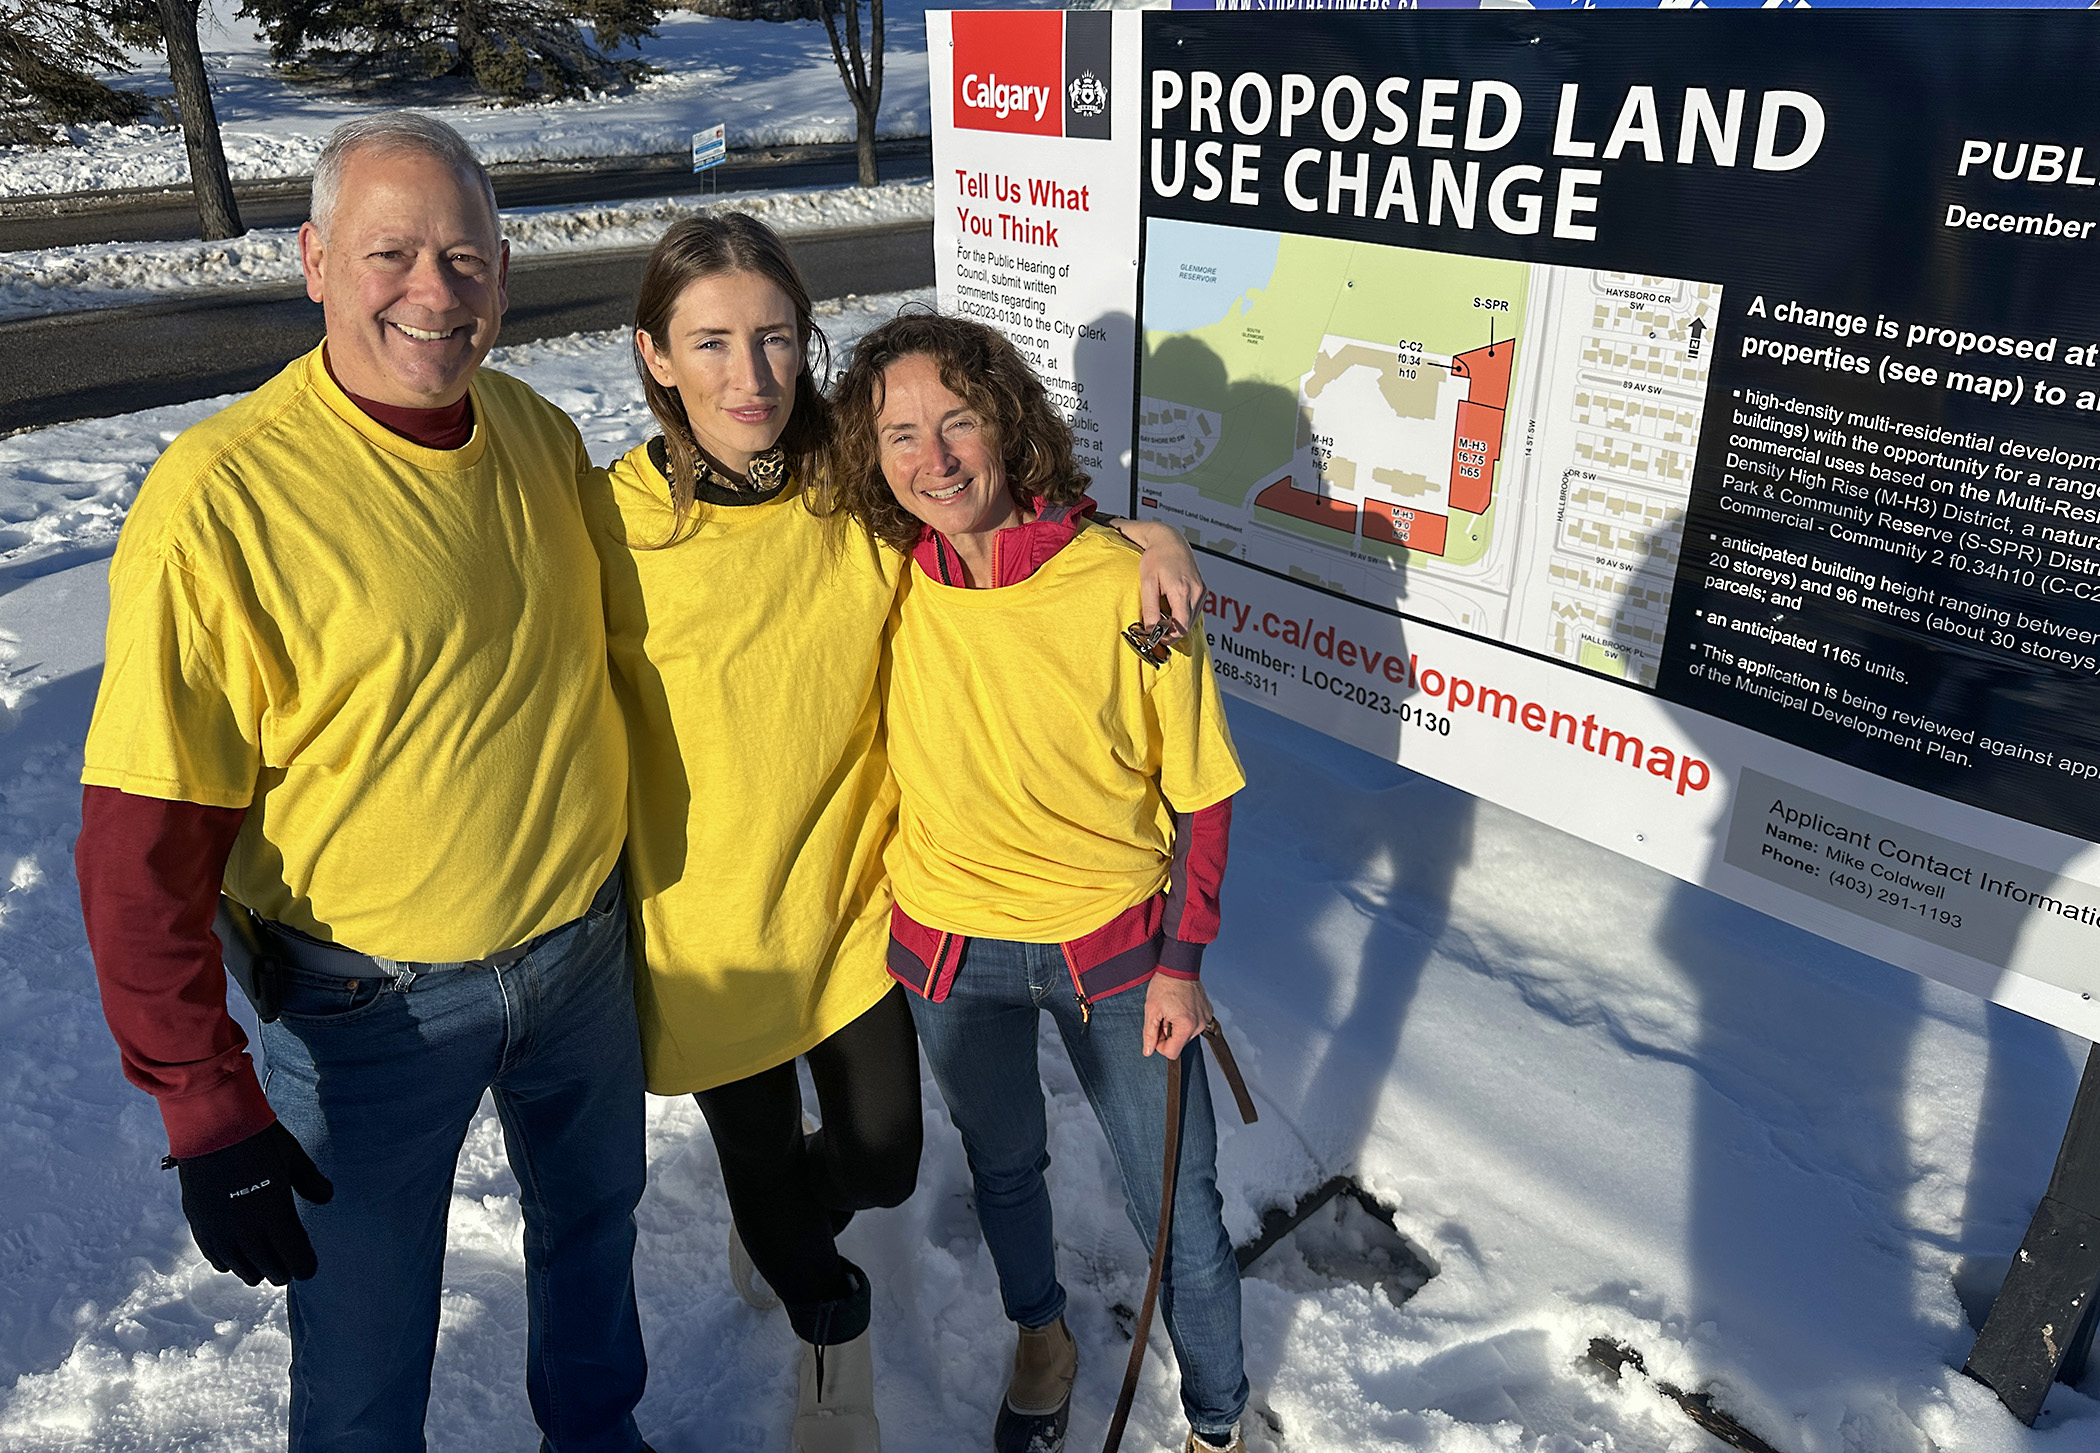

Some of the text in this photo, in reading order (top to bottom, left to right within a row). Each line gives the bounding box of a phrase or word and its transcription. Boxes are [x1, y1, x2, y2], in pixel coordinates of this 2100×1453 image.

[962, 74, 1049, 122] Calgary
[1150, 69, 1827, 174] PROPOSED LAND
[1957, 140, 2100, 186] PUBL
[956, 170, 1089, 211] Tell Us What
[1149, 137, 1604, 242] USE CHANGE
[957, 207, 1059, 248] You Think
[1945, 204, 2096, 239] December
[957, 246, 1069, 279] For the Public Hearing of
[957, 264, 1056, 294] Council, submit written
[1179, 272, 1217, 283] RESERVOIR
[1180, 264, 1217, 275] GLENMORE
[957, 285, 1045, 314] comments regarding
[1473, 298, 1509, 311] S-SPR
[1606, 288, 1655, 302] HAYSBORO
[1630, 302, 1644, 311] SW
[958, 300, 1107, 341] LOC2023-0130 to the City Clerk
[1747, 296, 2099, 367] A change is proposed at
[1011, 334, 1033, 346] noon
[1037, 338, 1049, 349] on
[1399, 340, 1423, 353] C-C2
[1398, 354, 1421, 366] f0.34
[1399, 368, 1416, 379] h10
[1742, 336, 2066, 405] properties (see map) to
[1623, 381, 1662, 394] 89 AV SW
[1067, 414, 1099, 432] Public
[1525, 420, 1535, 456] 14 ST SW
[1745, 389, 1994, 453] high-density multi-residential
[1311, 434, 1334, 446] M-H3
[1311, 446, 1332, 459] f5.75
[1459, 438, 1486, 452] M-H3
[1733, 409, 1809, 442] buildings)
[1814, 429, 1846, 447] with
[1852, 435, 1879, 454] the
[1883, 445, 1990, 480] opportunity
[1995, 463, 2023, 482] for
[2027, 473, 2041, 486] a
[1312, 459, 1328, 471] h65
[1458, 452, 1484, 465] f6.75
[1460, 466, 1480, 478] h65
[1730, 434, 1821, 464] commercial
[1825, 456, 1865, 475] uses
[1870, 462, 1925, 488] based
[1930, 479, 1954, 494] on
[1959, 483, 1990, 502] the
[1142, 487, 1162, 497] Legend
[1557, 469, 1596, 522] HALLBROOK DR SW
[1727, 453, 2034, 536] Density High Rise (M-H3) District, a
[1159, 502, 1183, 516] Proposed
[1185, 510, 1198, 518] Land
[1211, 518, 1242, 533] Amendment
[1393, 508, 1414, 520] M-H3
[1722, 474, 2042, 567] Park & Community Reserve (S-SPR)
[1393, 530, 1409, 540] h96
[1720, 496, 2035, 587] Commercial Community 2 f0.34h10
[1596, 557, 1633, 572] 90 AV SW
[1722, 536, 1808, 568] anticipated
[1812, 557, 1876, 590] building
[1880, 575, 1935, 604] height
[1939, 596, 2011, 627] ranging
[1704, 575, 1802, 611] parcels; and
[1709, 552, 1730, 569] 20
[1733, 559, 1797, 590] storeys)
[1800, 579, 1832, 597] and
[1836, 588, 1857, 604] 96
[1861, 595, 1921, 623] metres
[1926, 612, 1985, 642] (about
[1990, 631, 2014, 649] 30
[1581, 633, 1644, 657] HALLBROOK PL
[1604, 650, 1619, 659] SW
[1707, 613, 1909, 685] an anticipated 1165 units.
[1202, 590, 1711, 796] ary.ca/developmentmap
[1221, 633, 1450, 736] Number: LOC2023-0130
[1689, 664, 1973, 768] of the Municipal Development Plan.
[1702, 643, 2053, 766] This application is being reviewed against
[1769, 799, 1872, 850] Applicant
[1878, 839, 1973, 885] Contact
[1765, 822, 1946, 899] Name: Mike Coldwell
[1761, 843, 1963, 929] Phone: (403) 291-1193
[230, 1180, 270, 1198] HEAD
